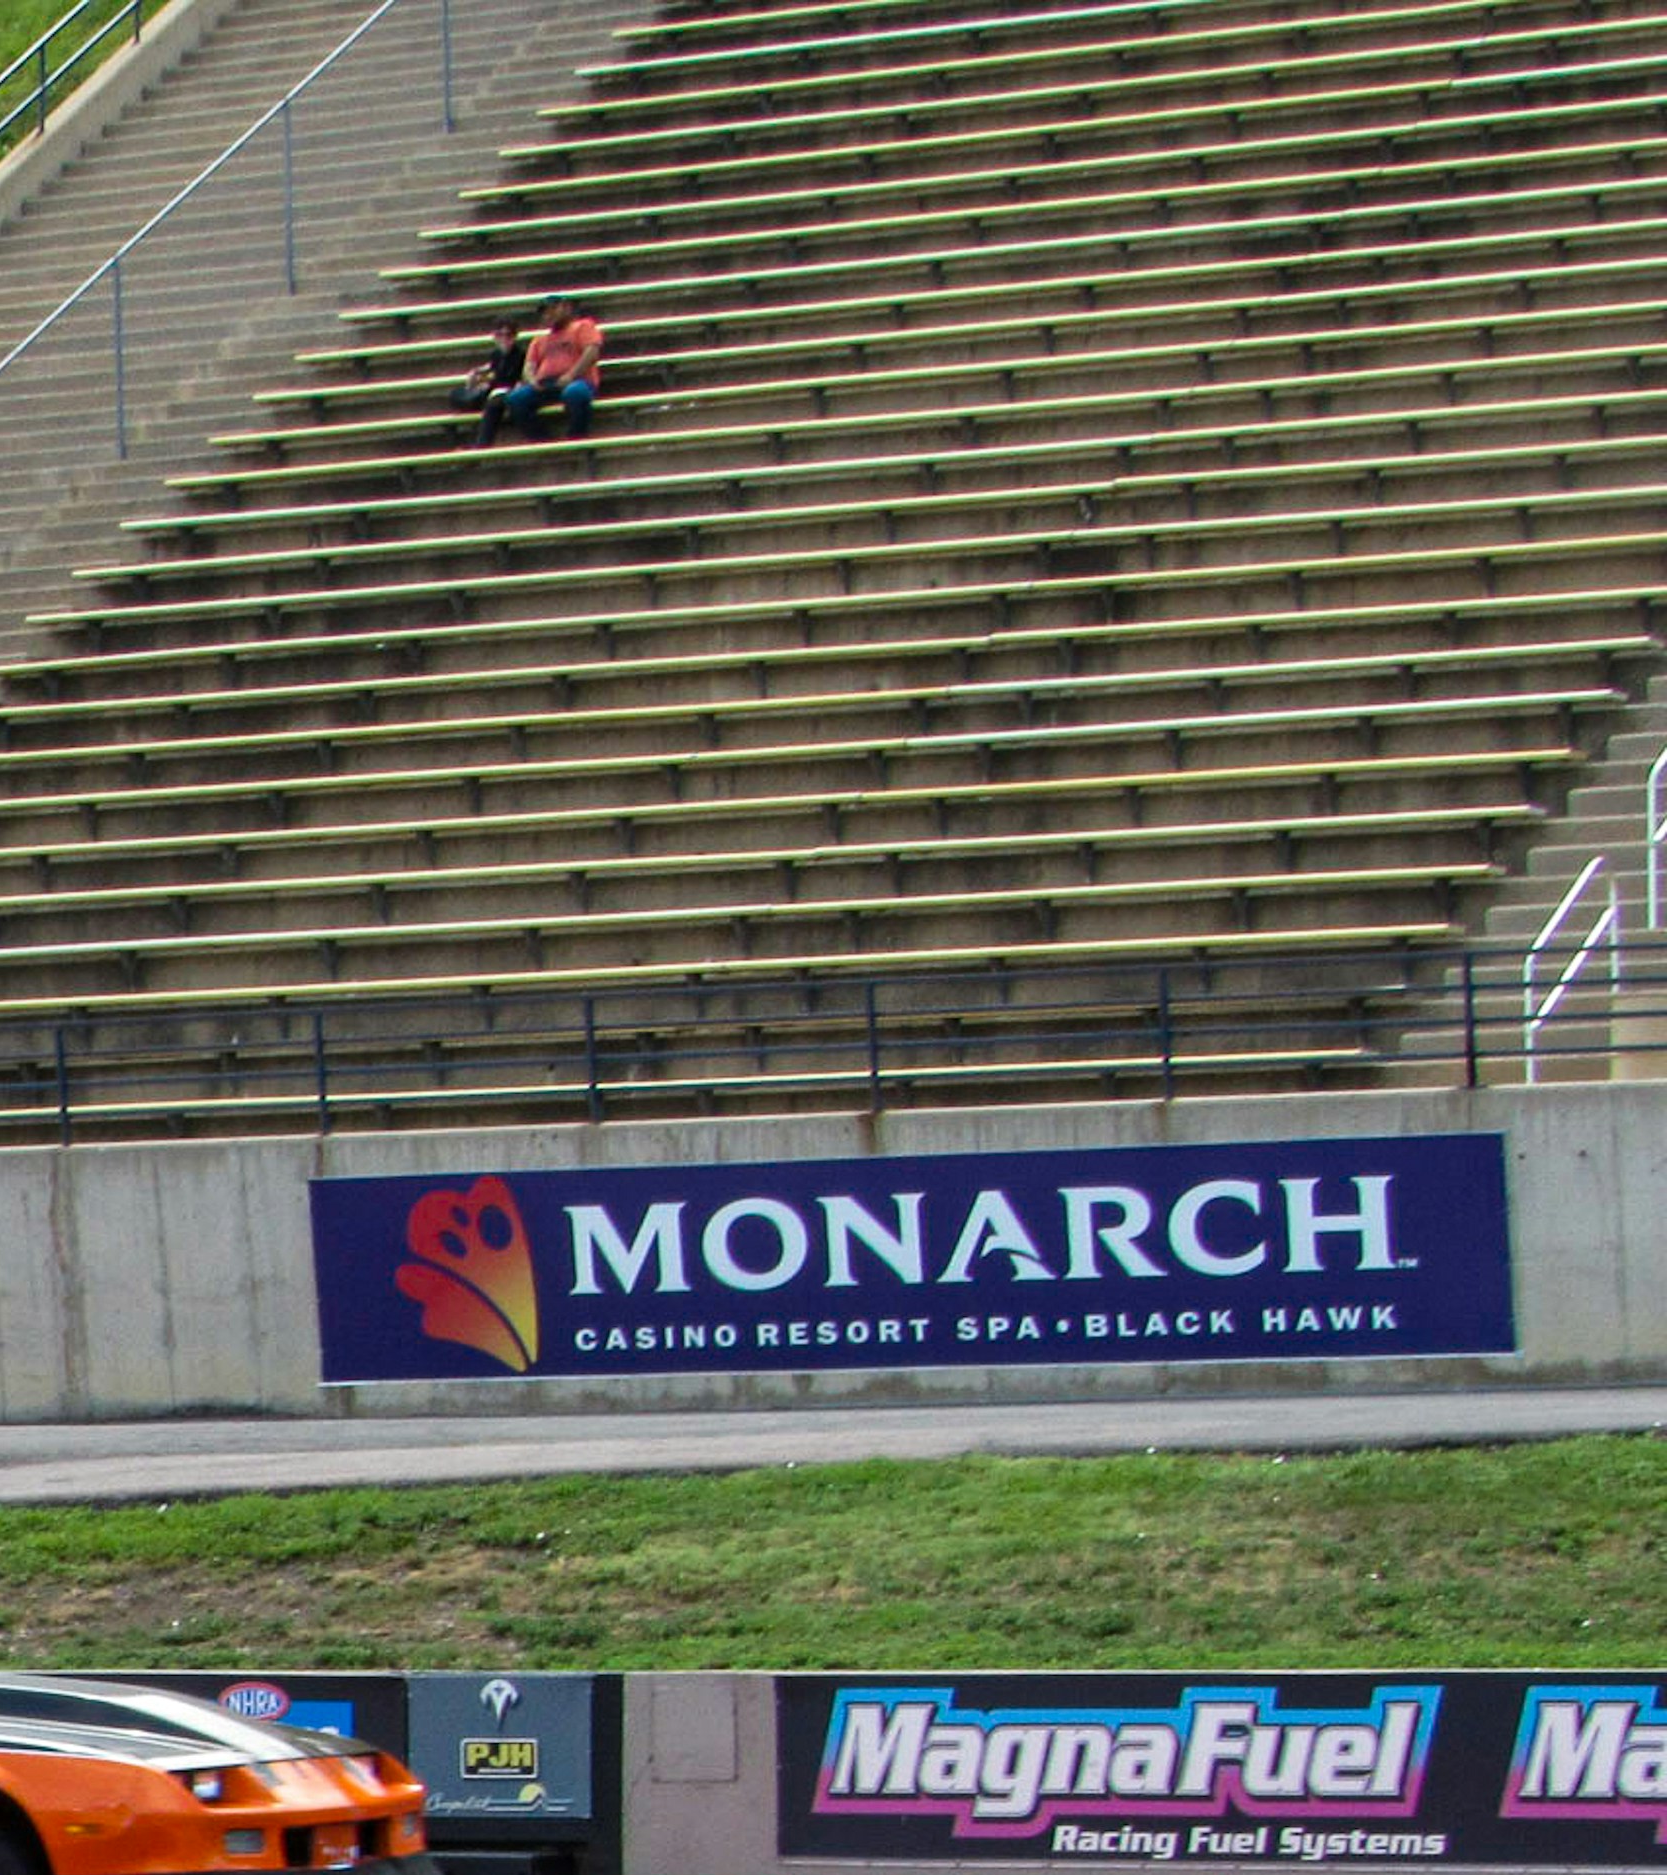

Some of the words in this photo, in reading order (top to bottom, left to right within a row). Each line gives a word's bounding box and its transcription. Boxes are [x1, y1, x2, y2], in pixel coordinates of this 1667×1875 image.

[563, 1174, 1401, 1295] MONARCH
[575, 1324, 737, 1352] CASINO
[757, 1318, 931, 1347] RESORT
[957, 1316, 1041, 1341] SPA
[1084, 1309, 1234, 1338] BLACK
[1262, 1304, 1399, 1332] HAWK
[228, 1687, 281, 1714] NHRA
[467, 1743, 533, 1767] PJH
[828, 1700, 1420, 1819] MagnaFuel
[1051, 1825, 1177, 1860] Racing
[1188, 1826, 1265, 1854] Fuel
[1278, 1826, 1446, 1861] Systems
